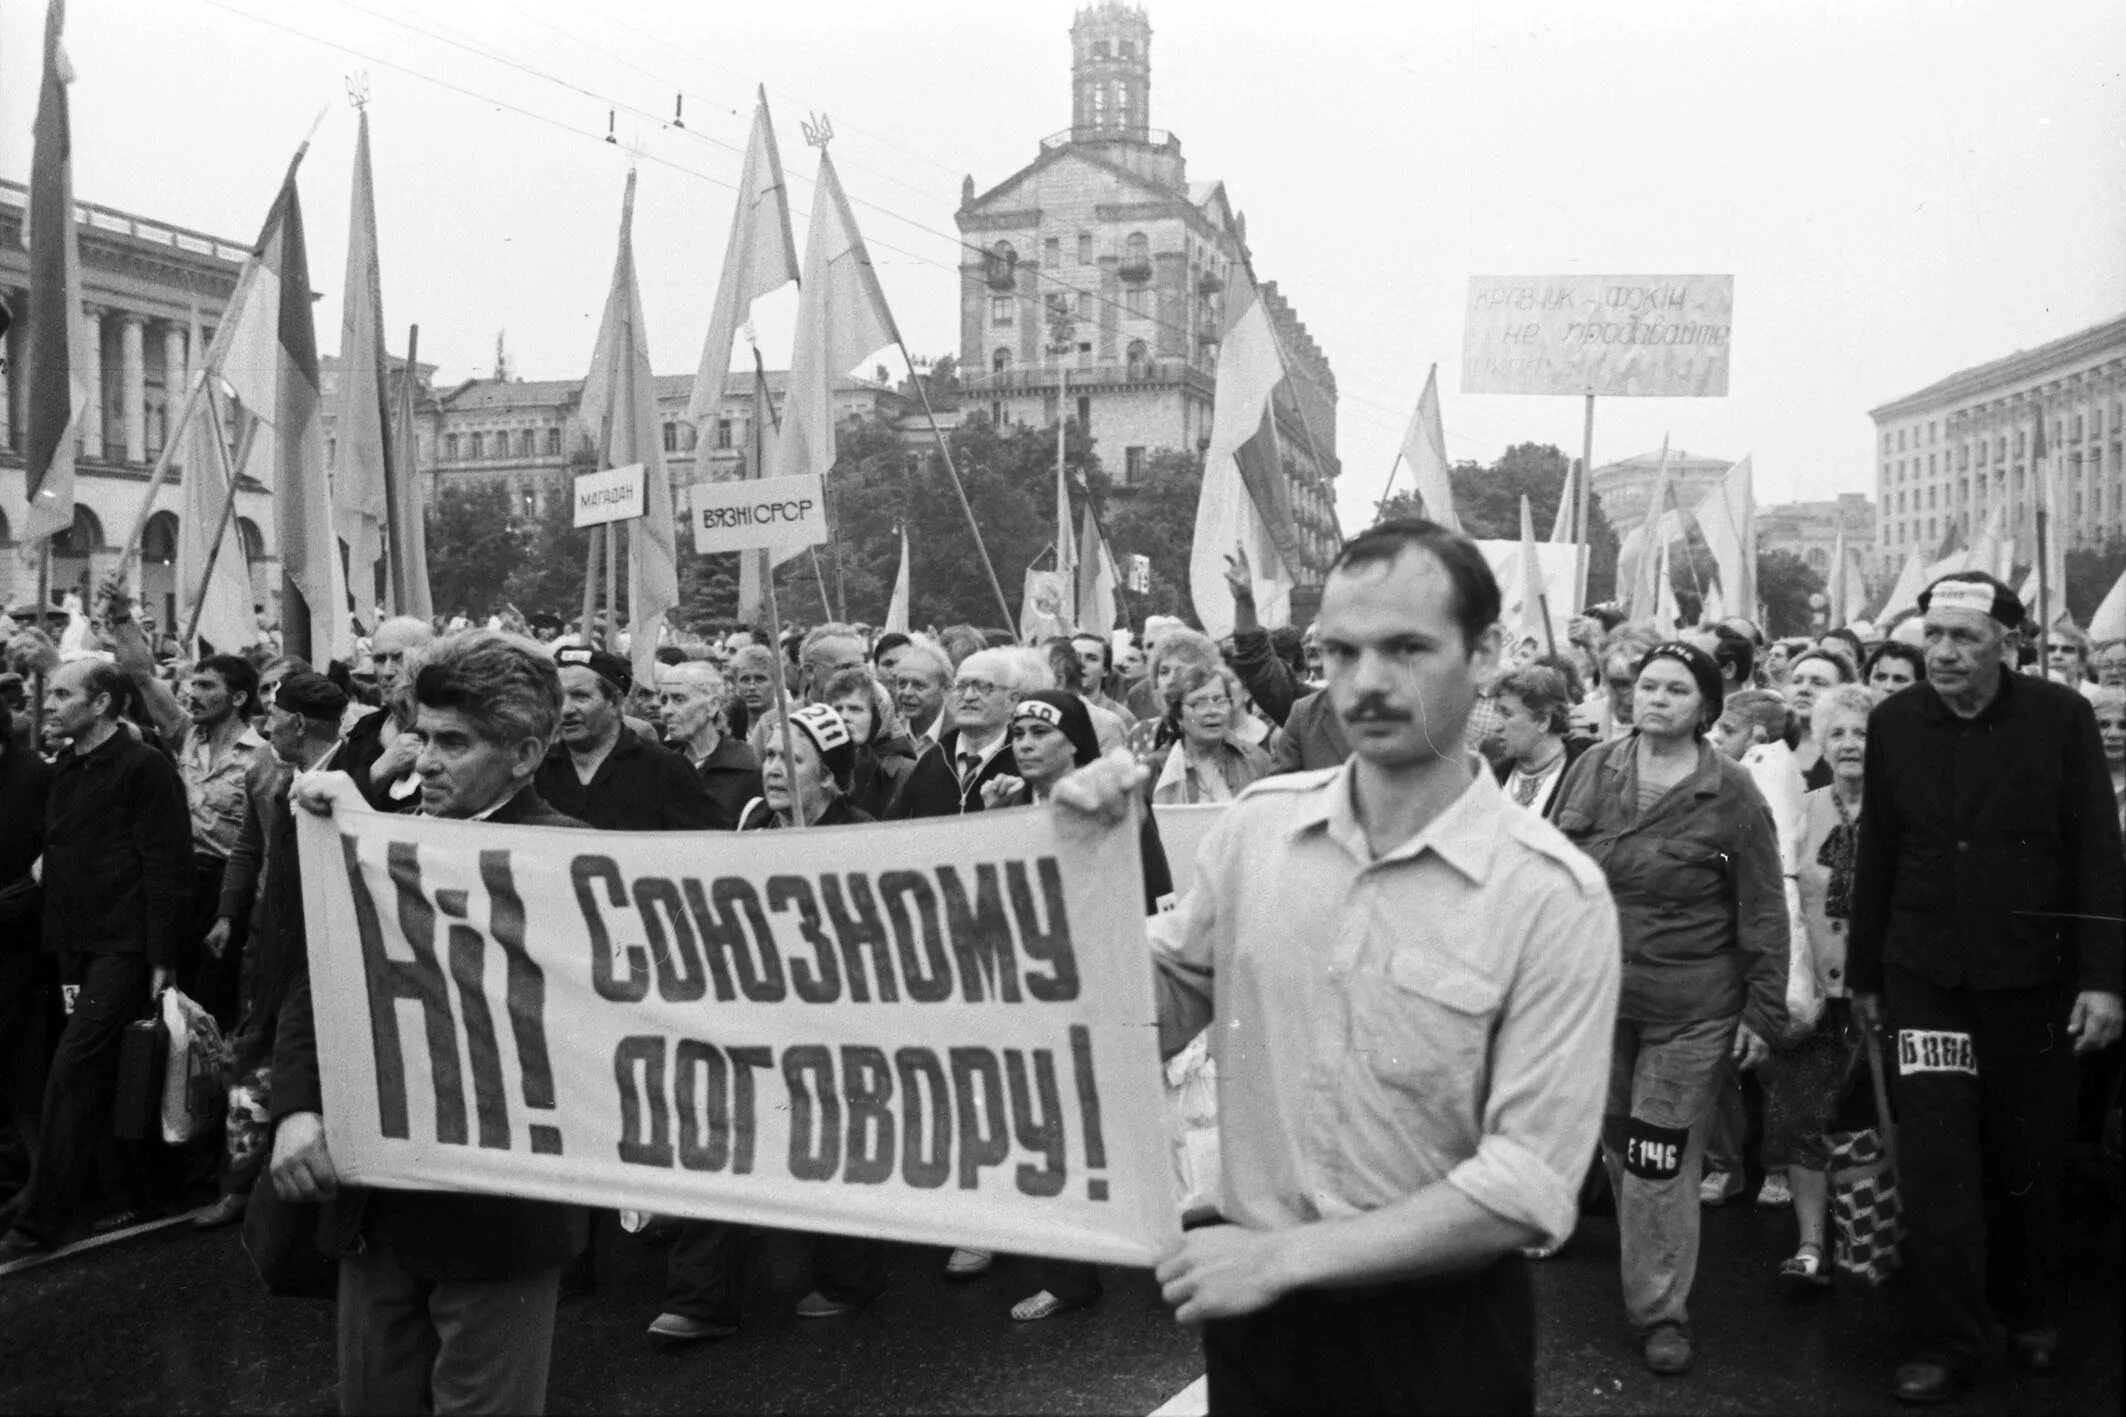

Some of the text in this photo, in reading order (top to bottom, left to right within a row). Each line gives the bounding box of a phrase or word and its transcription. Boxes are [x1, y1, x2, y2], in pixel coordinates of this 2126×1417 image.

[580, 483, 634, 509] МАГАДАН
[702, 499, 813, 529] ВЯЗНІ СРСР
[341, 832, 563, 1155] НІ!
[613, 1023, 1110, 1202] ДОГОВОРУ!
